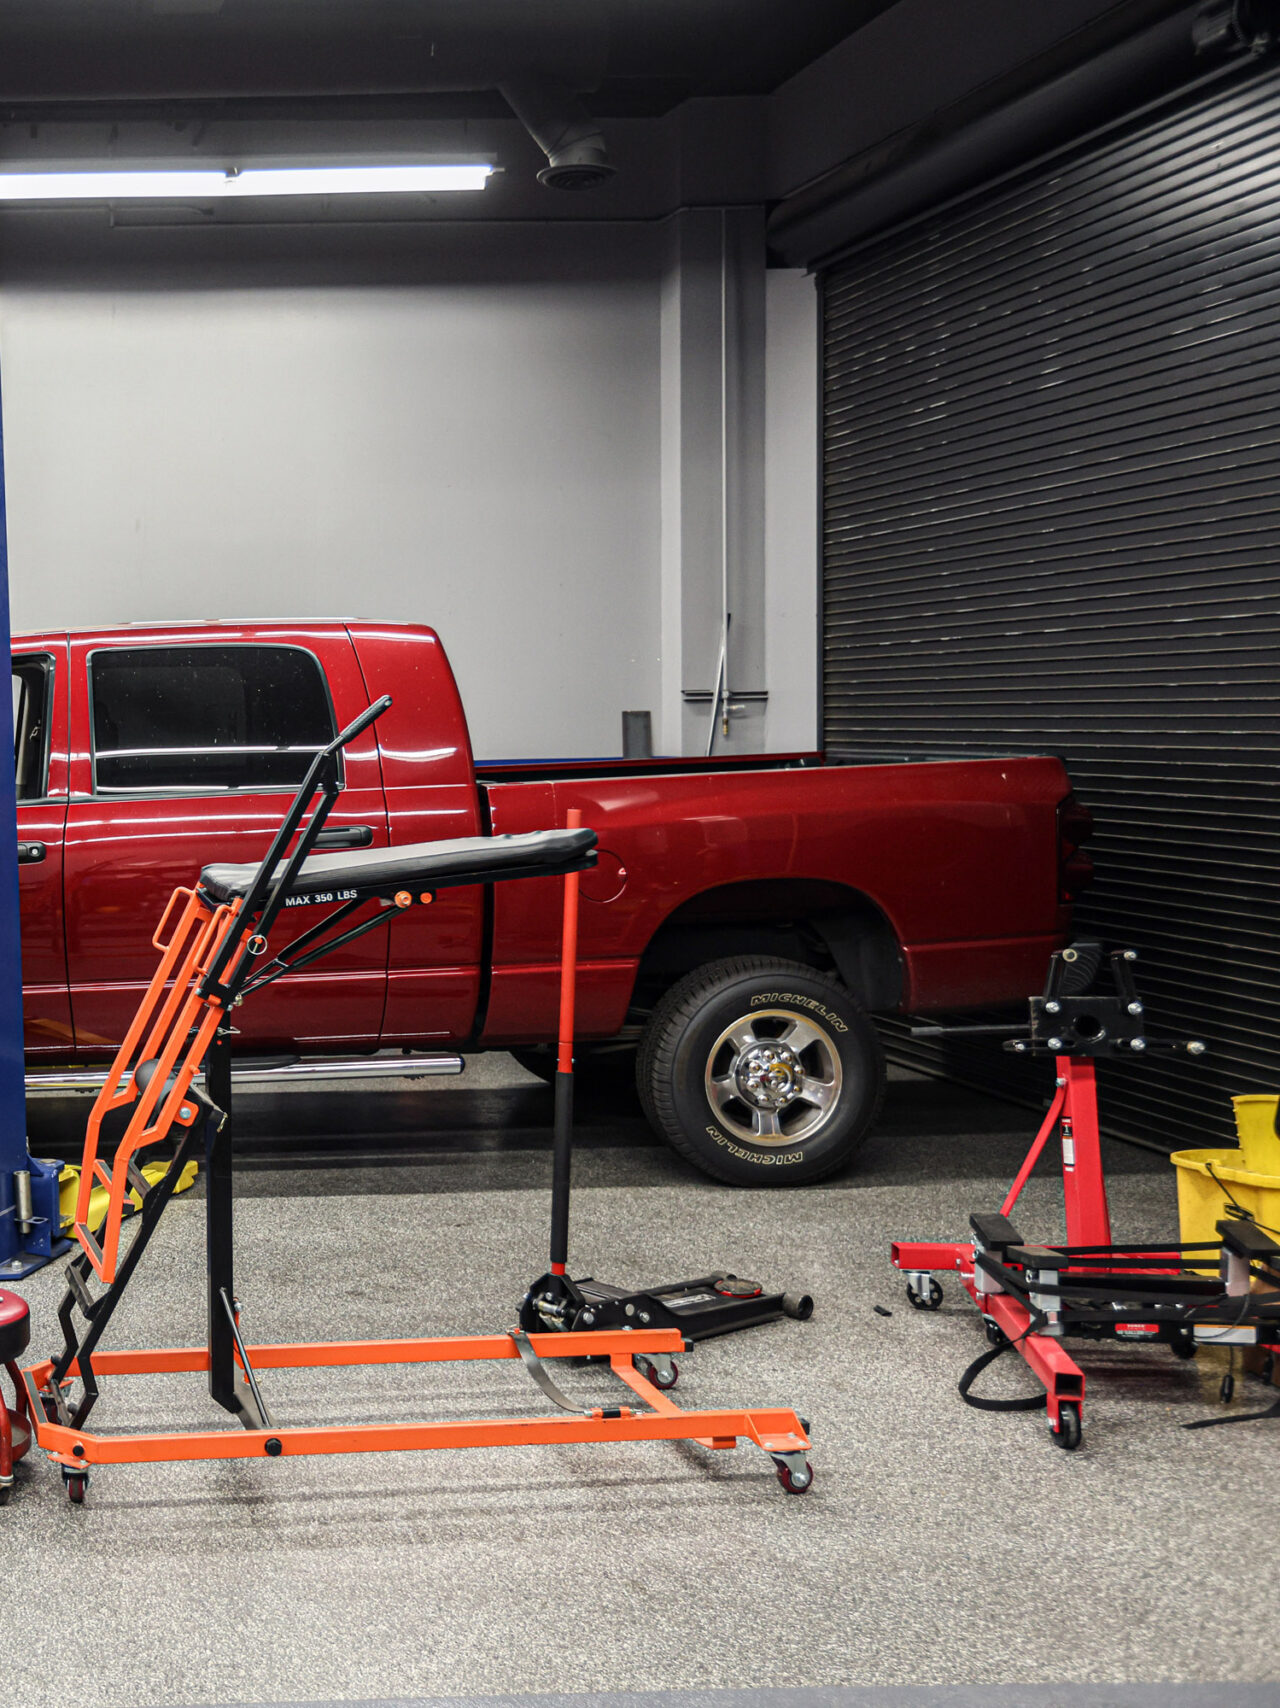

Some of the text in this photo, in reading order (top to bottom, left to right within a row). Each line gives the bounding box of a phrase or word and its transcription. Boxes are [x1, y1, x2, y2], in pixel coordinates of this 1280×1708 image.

[285, 889, 358, 907] MAX 350 LBS
[750, 992, 848, 1033] MICHELIN
[705, 1125, 803, 1165] MICHELIN
